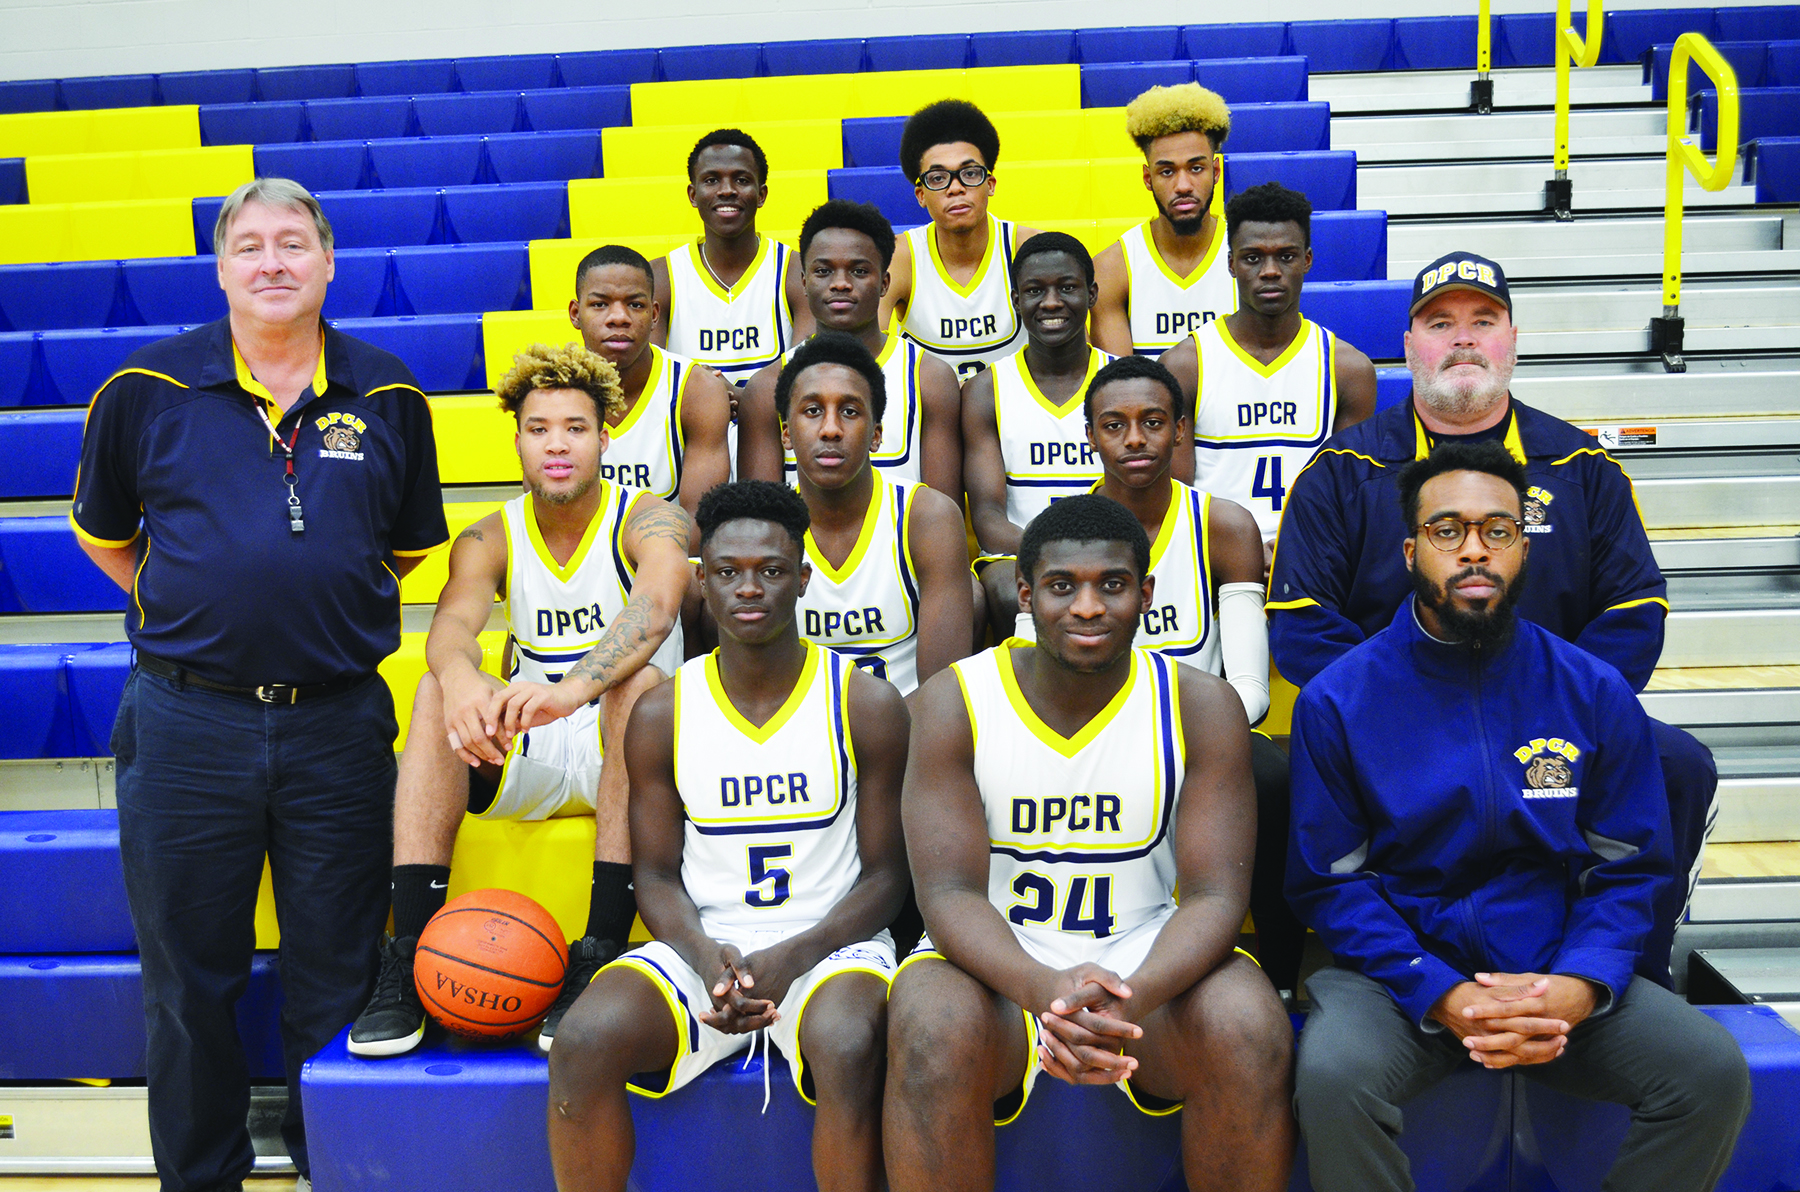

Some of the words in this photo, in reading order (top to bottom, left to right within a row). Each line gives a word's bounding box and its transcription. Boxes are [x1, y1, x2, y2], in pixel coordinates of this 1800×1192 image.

[1421, 260, 1497, 294] DPCR
[699, 325, 760, 352] DPCR
[940, 313, 998, 339] DPCR
[315, 411, 367, 434] DPCR
[1237, 401, 1297, 427] DPCR
[319, 449, 364, 461] BRUINS
[1029, 441, 1095, 467] DPCR
[600, 463, 652, 489] PCR
[1250, 453, 1286, 514] 4
[1526, 486, 1553, 506] CR
[1523, 524, 1553, 534] UINS
[536, 601, 607, 638] DPCR
[804, 605, 887, 638] DPCR
[1143, 603, 1180, 637] CR
[1513, 737, 1580, 764] DPCR
[720, 771, 811, 808] DPCR
[1521, 787, 1578, 799] BRUINS
[1010, 792, 1123, 835] DPCR
[742, 841, 795, 910] 5
[1006, 869, 1118, 939] 24
[436, 970, 522, 1013] OHSAA
